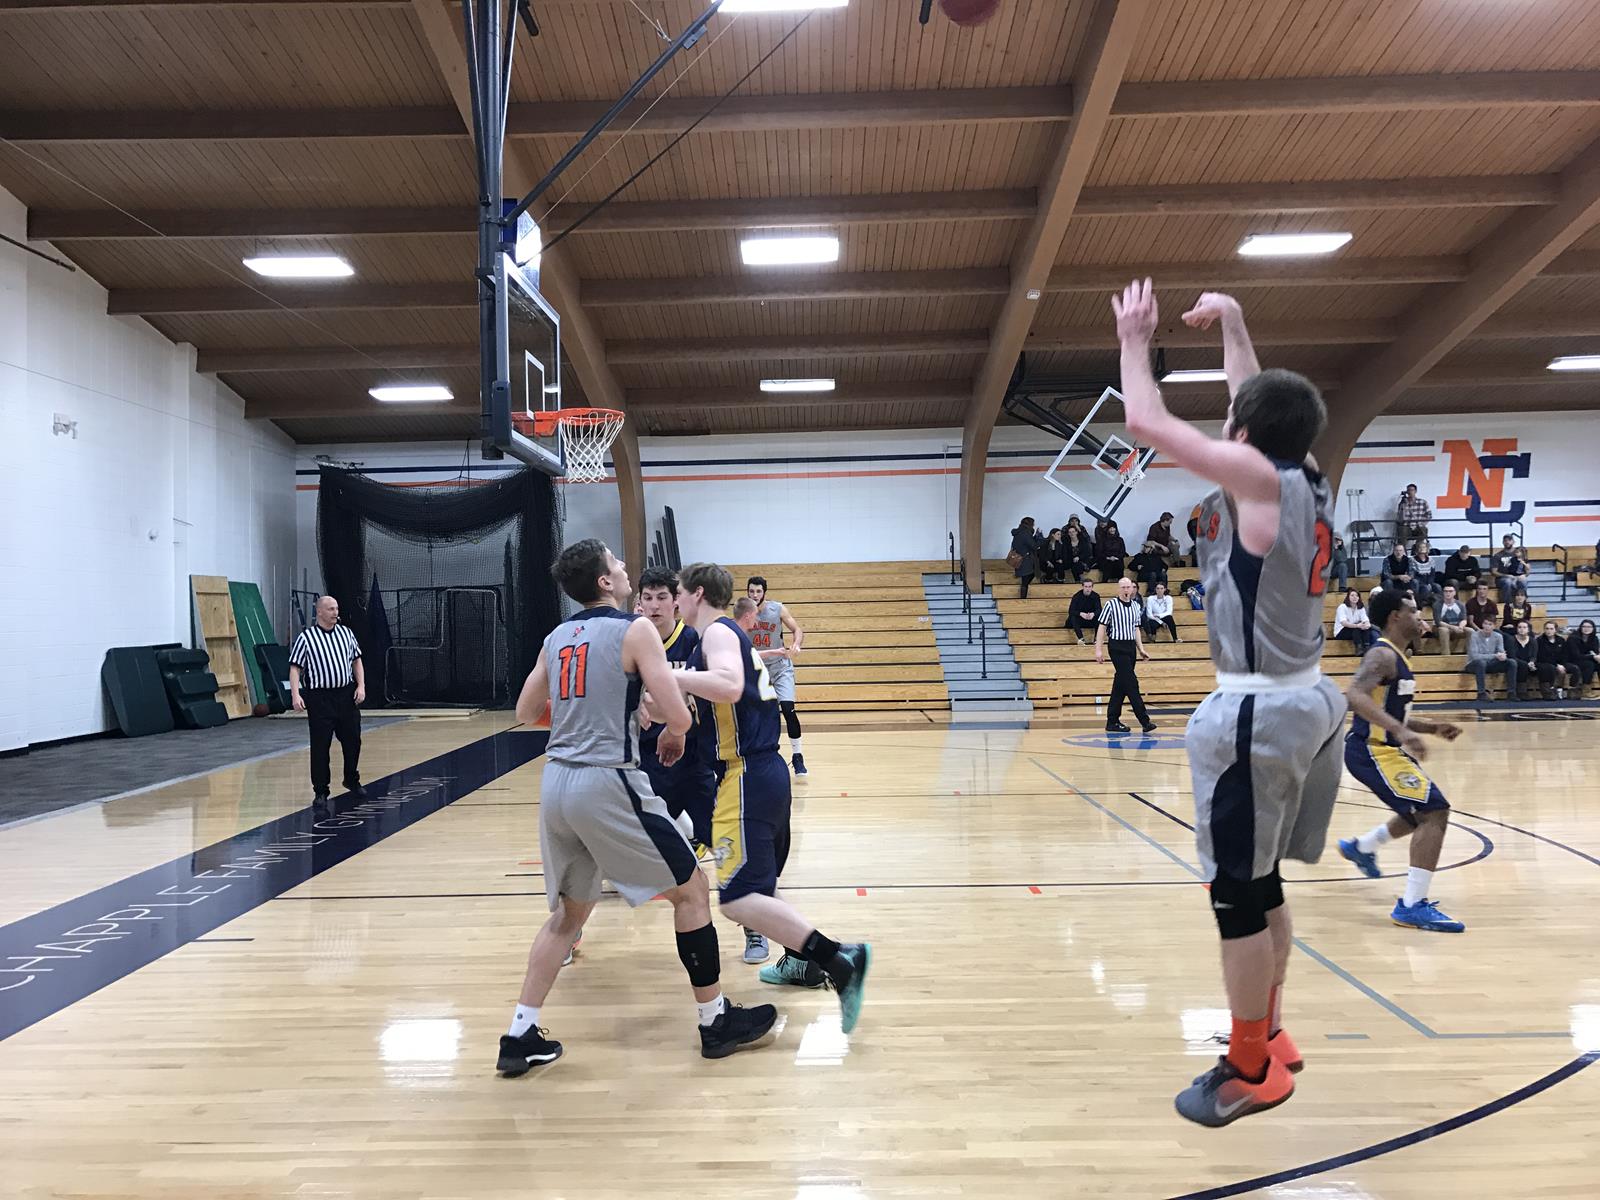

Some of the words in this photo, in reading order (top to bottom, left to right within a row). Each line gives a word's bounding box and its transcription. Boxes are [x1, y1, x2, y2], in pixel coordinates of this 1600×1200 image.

[1436, 438, 1532, 524] NC
[1307, 519, 1334, 597] 2
[753, 633, 771, 647] 44
[559, 642, 590, 700] 11
[192, 831, 337, 878] FAMILY
